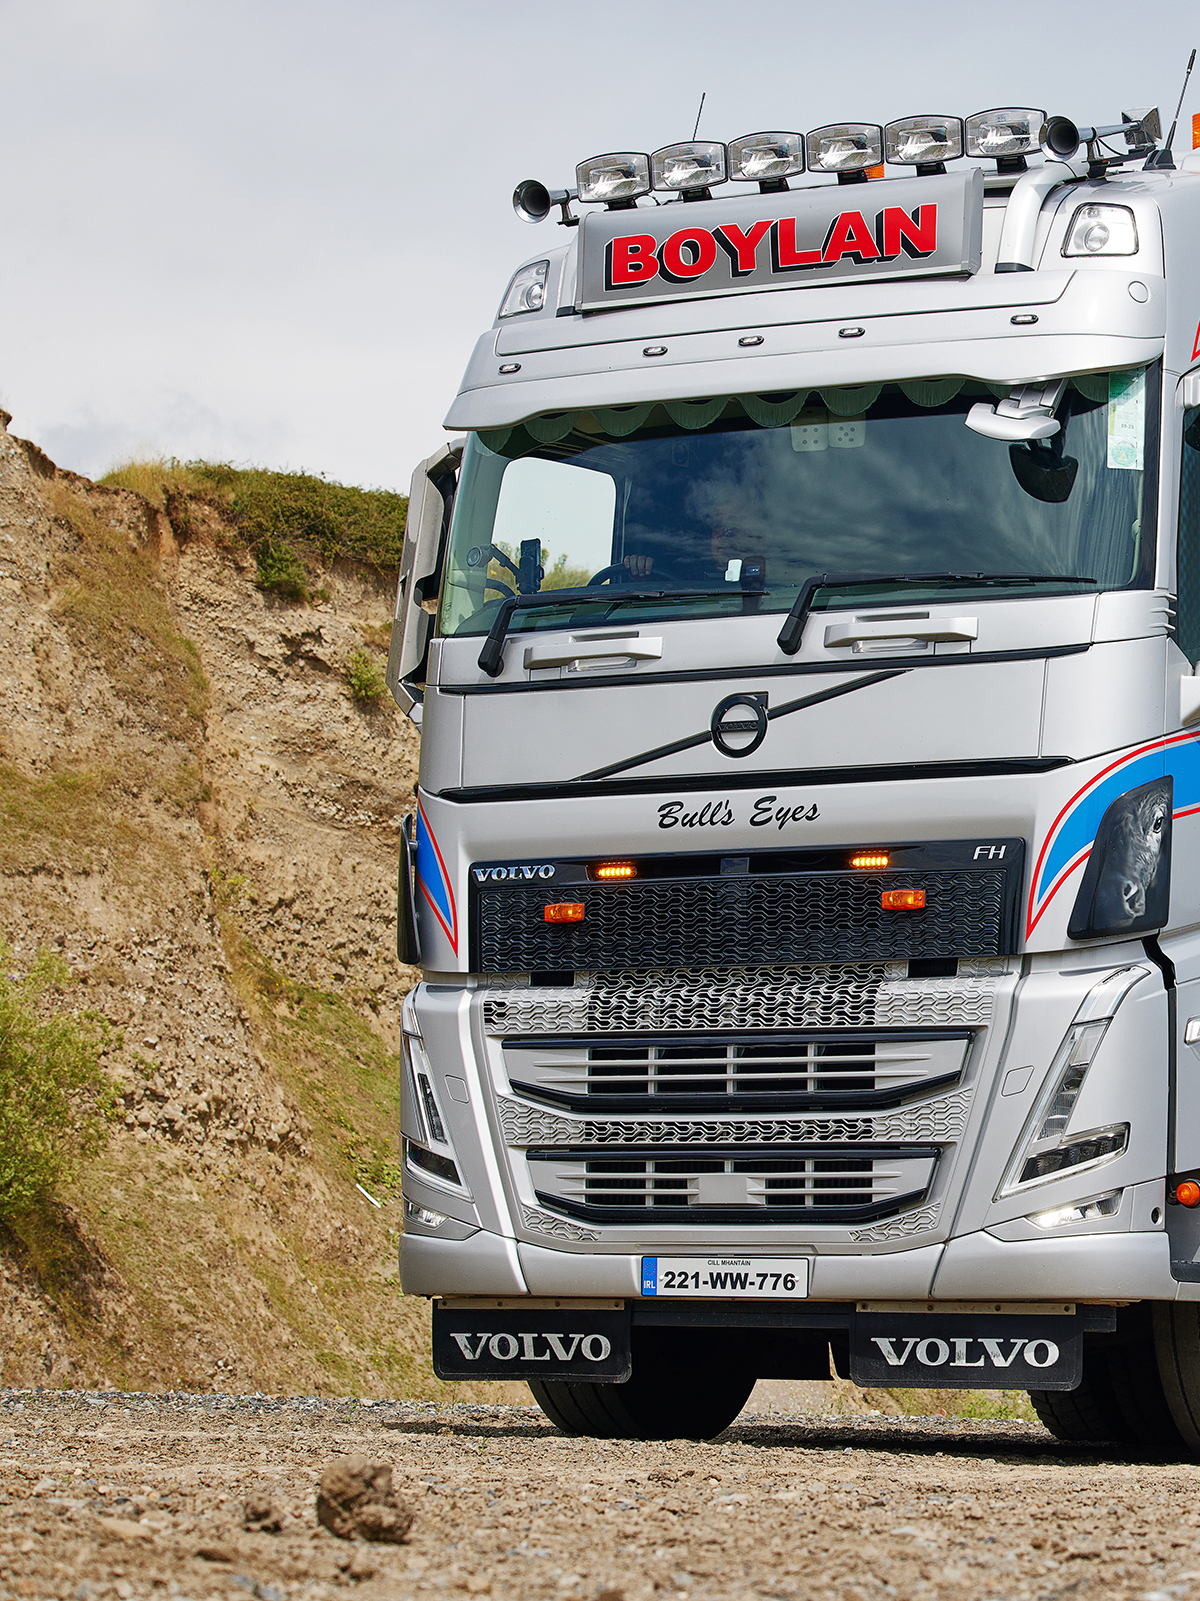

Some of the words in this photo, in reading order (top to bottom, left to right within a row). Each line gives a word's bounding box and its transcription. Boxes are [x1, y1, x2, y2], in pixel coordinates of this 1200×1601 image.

[604, 203, 939, 291] BOYLAN
[717, 721, 759, 731] VOLVO
[657, 798, 735, 830] Bull's
[749, 795, 821, 831] Eyes
[973, 845, 1007, 860] FH
[473, 864, 556, 883] VOLVO
[643, 1279, 656, 1289] IRL
[663, 1270, 796, 1291] 221-WW-776
[450, 1332, 612, 1362] VOLVO
[871, 1336, 1061, 1368] VOLVO
